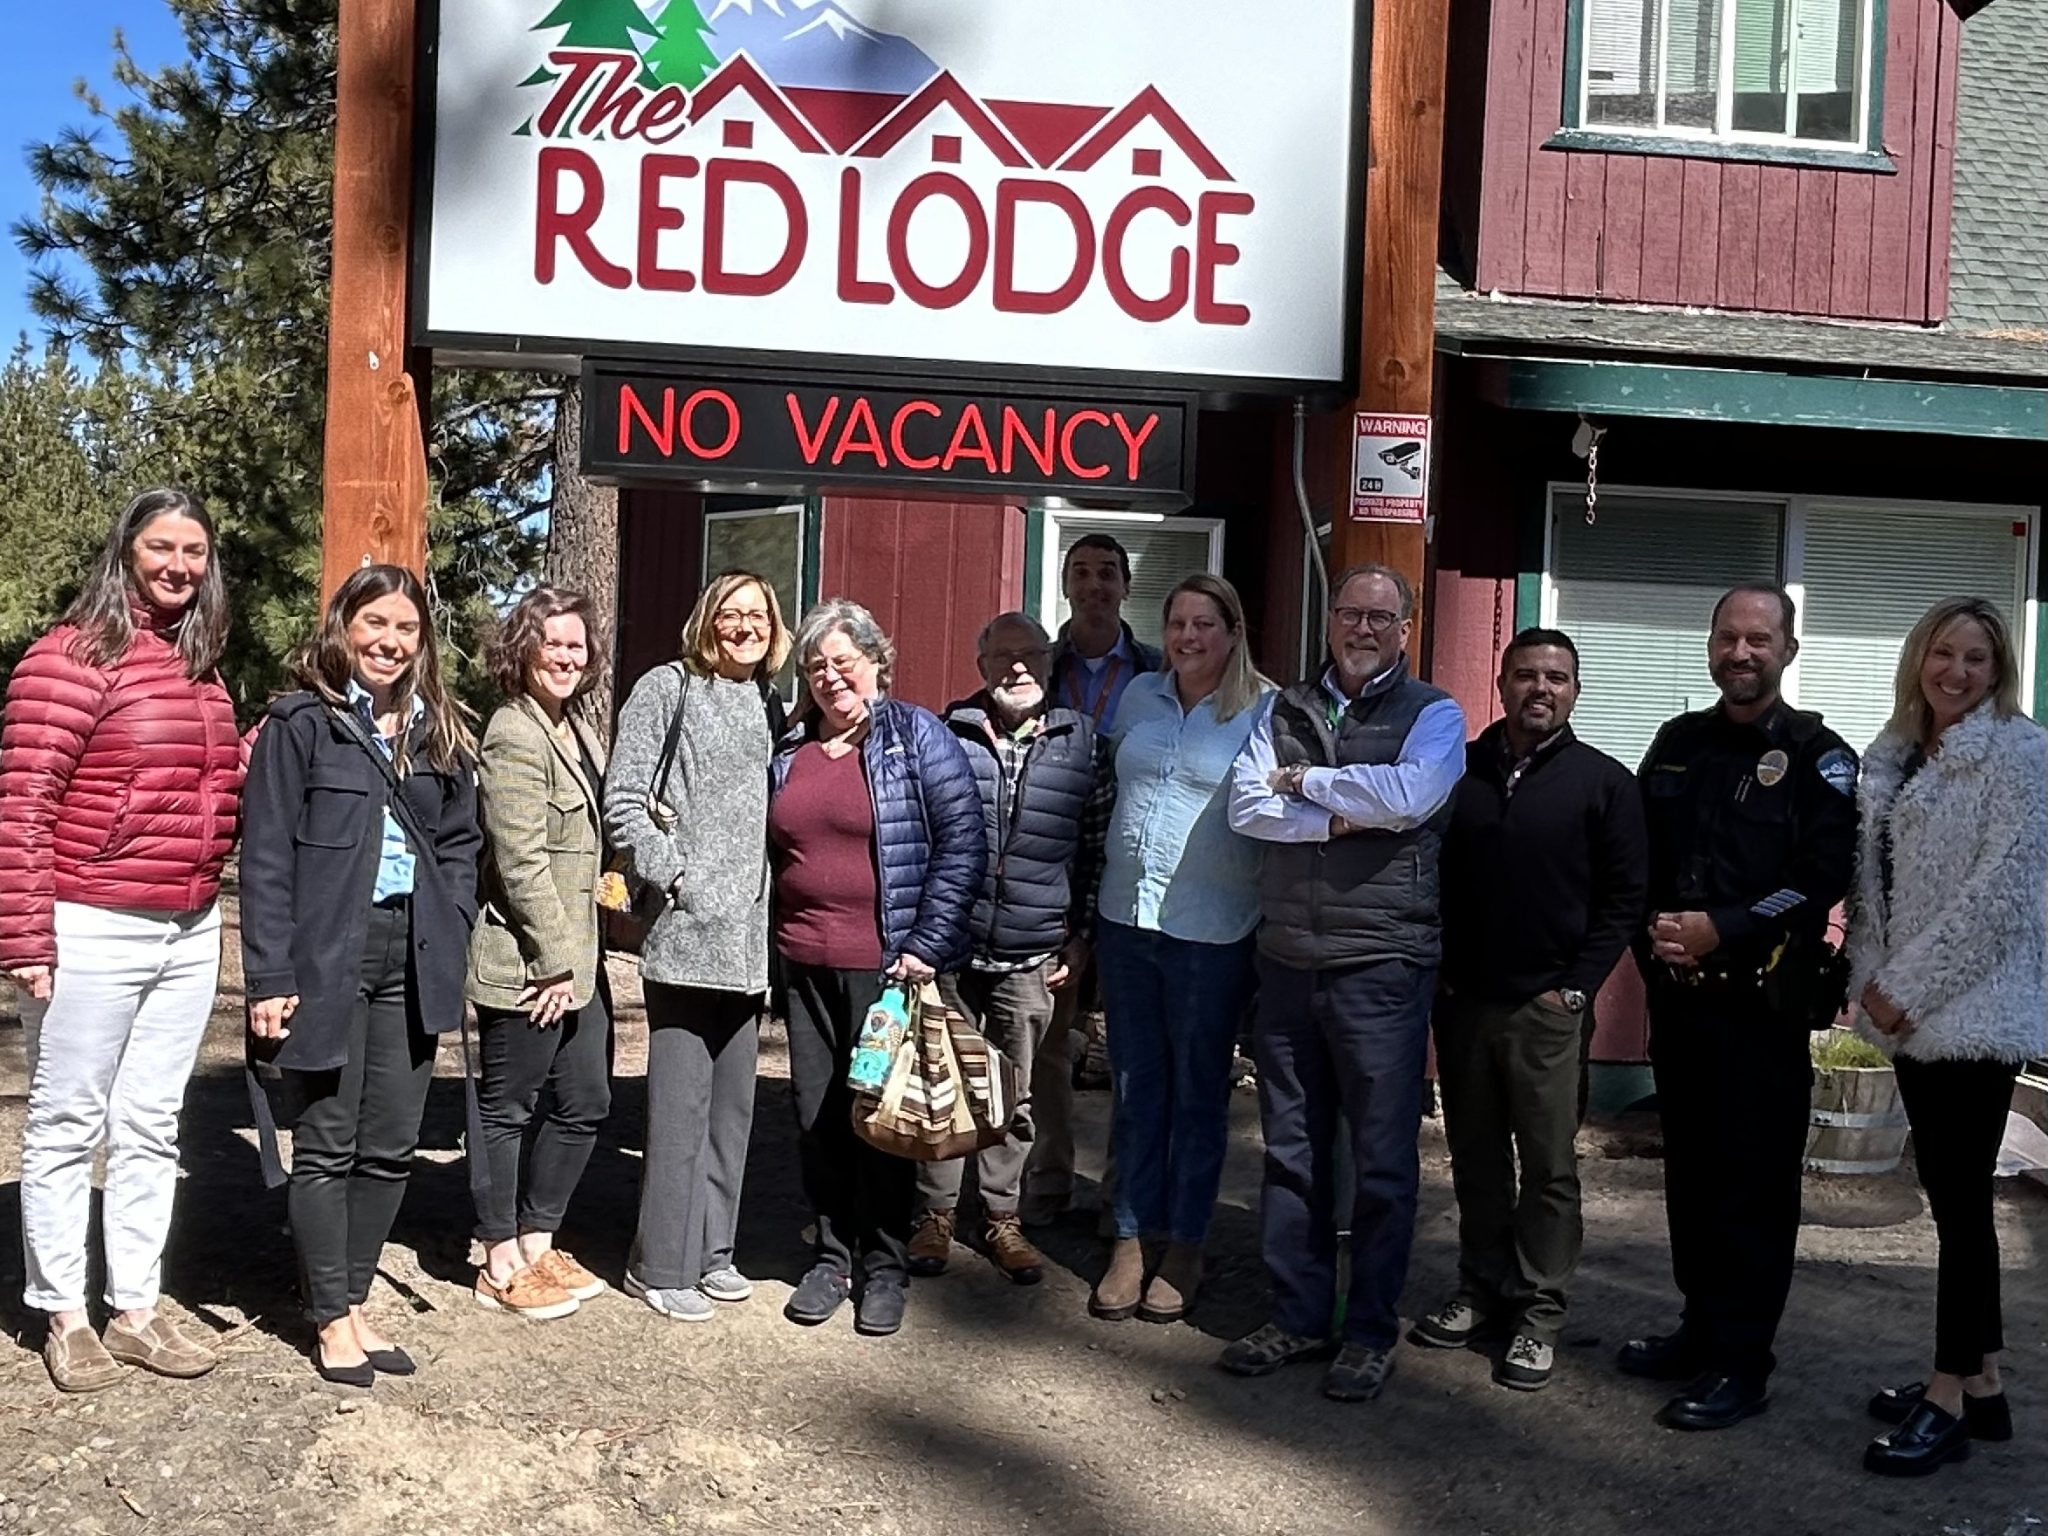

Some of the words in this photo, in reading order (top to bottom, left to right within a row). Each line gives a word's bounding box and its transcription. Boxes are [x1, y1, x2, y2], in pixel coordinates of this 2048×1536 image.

[538, 51, 691, 143] The
[534, 148, 808, 297] RED
[837, 166, 1255, 326] LODGE
[618, 383, 742, 460] NO
[786, 393, 1161, 481] VACANCY
[1359, 419, 1426, 435] WARNING
[1361, 480, 1373, 490] 24
